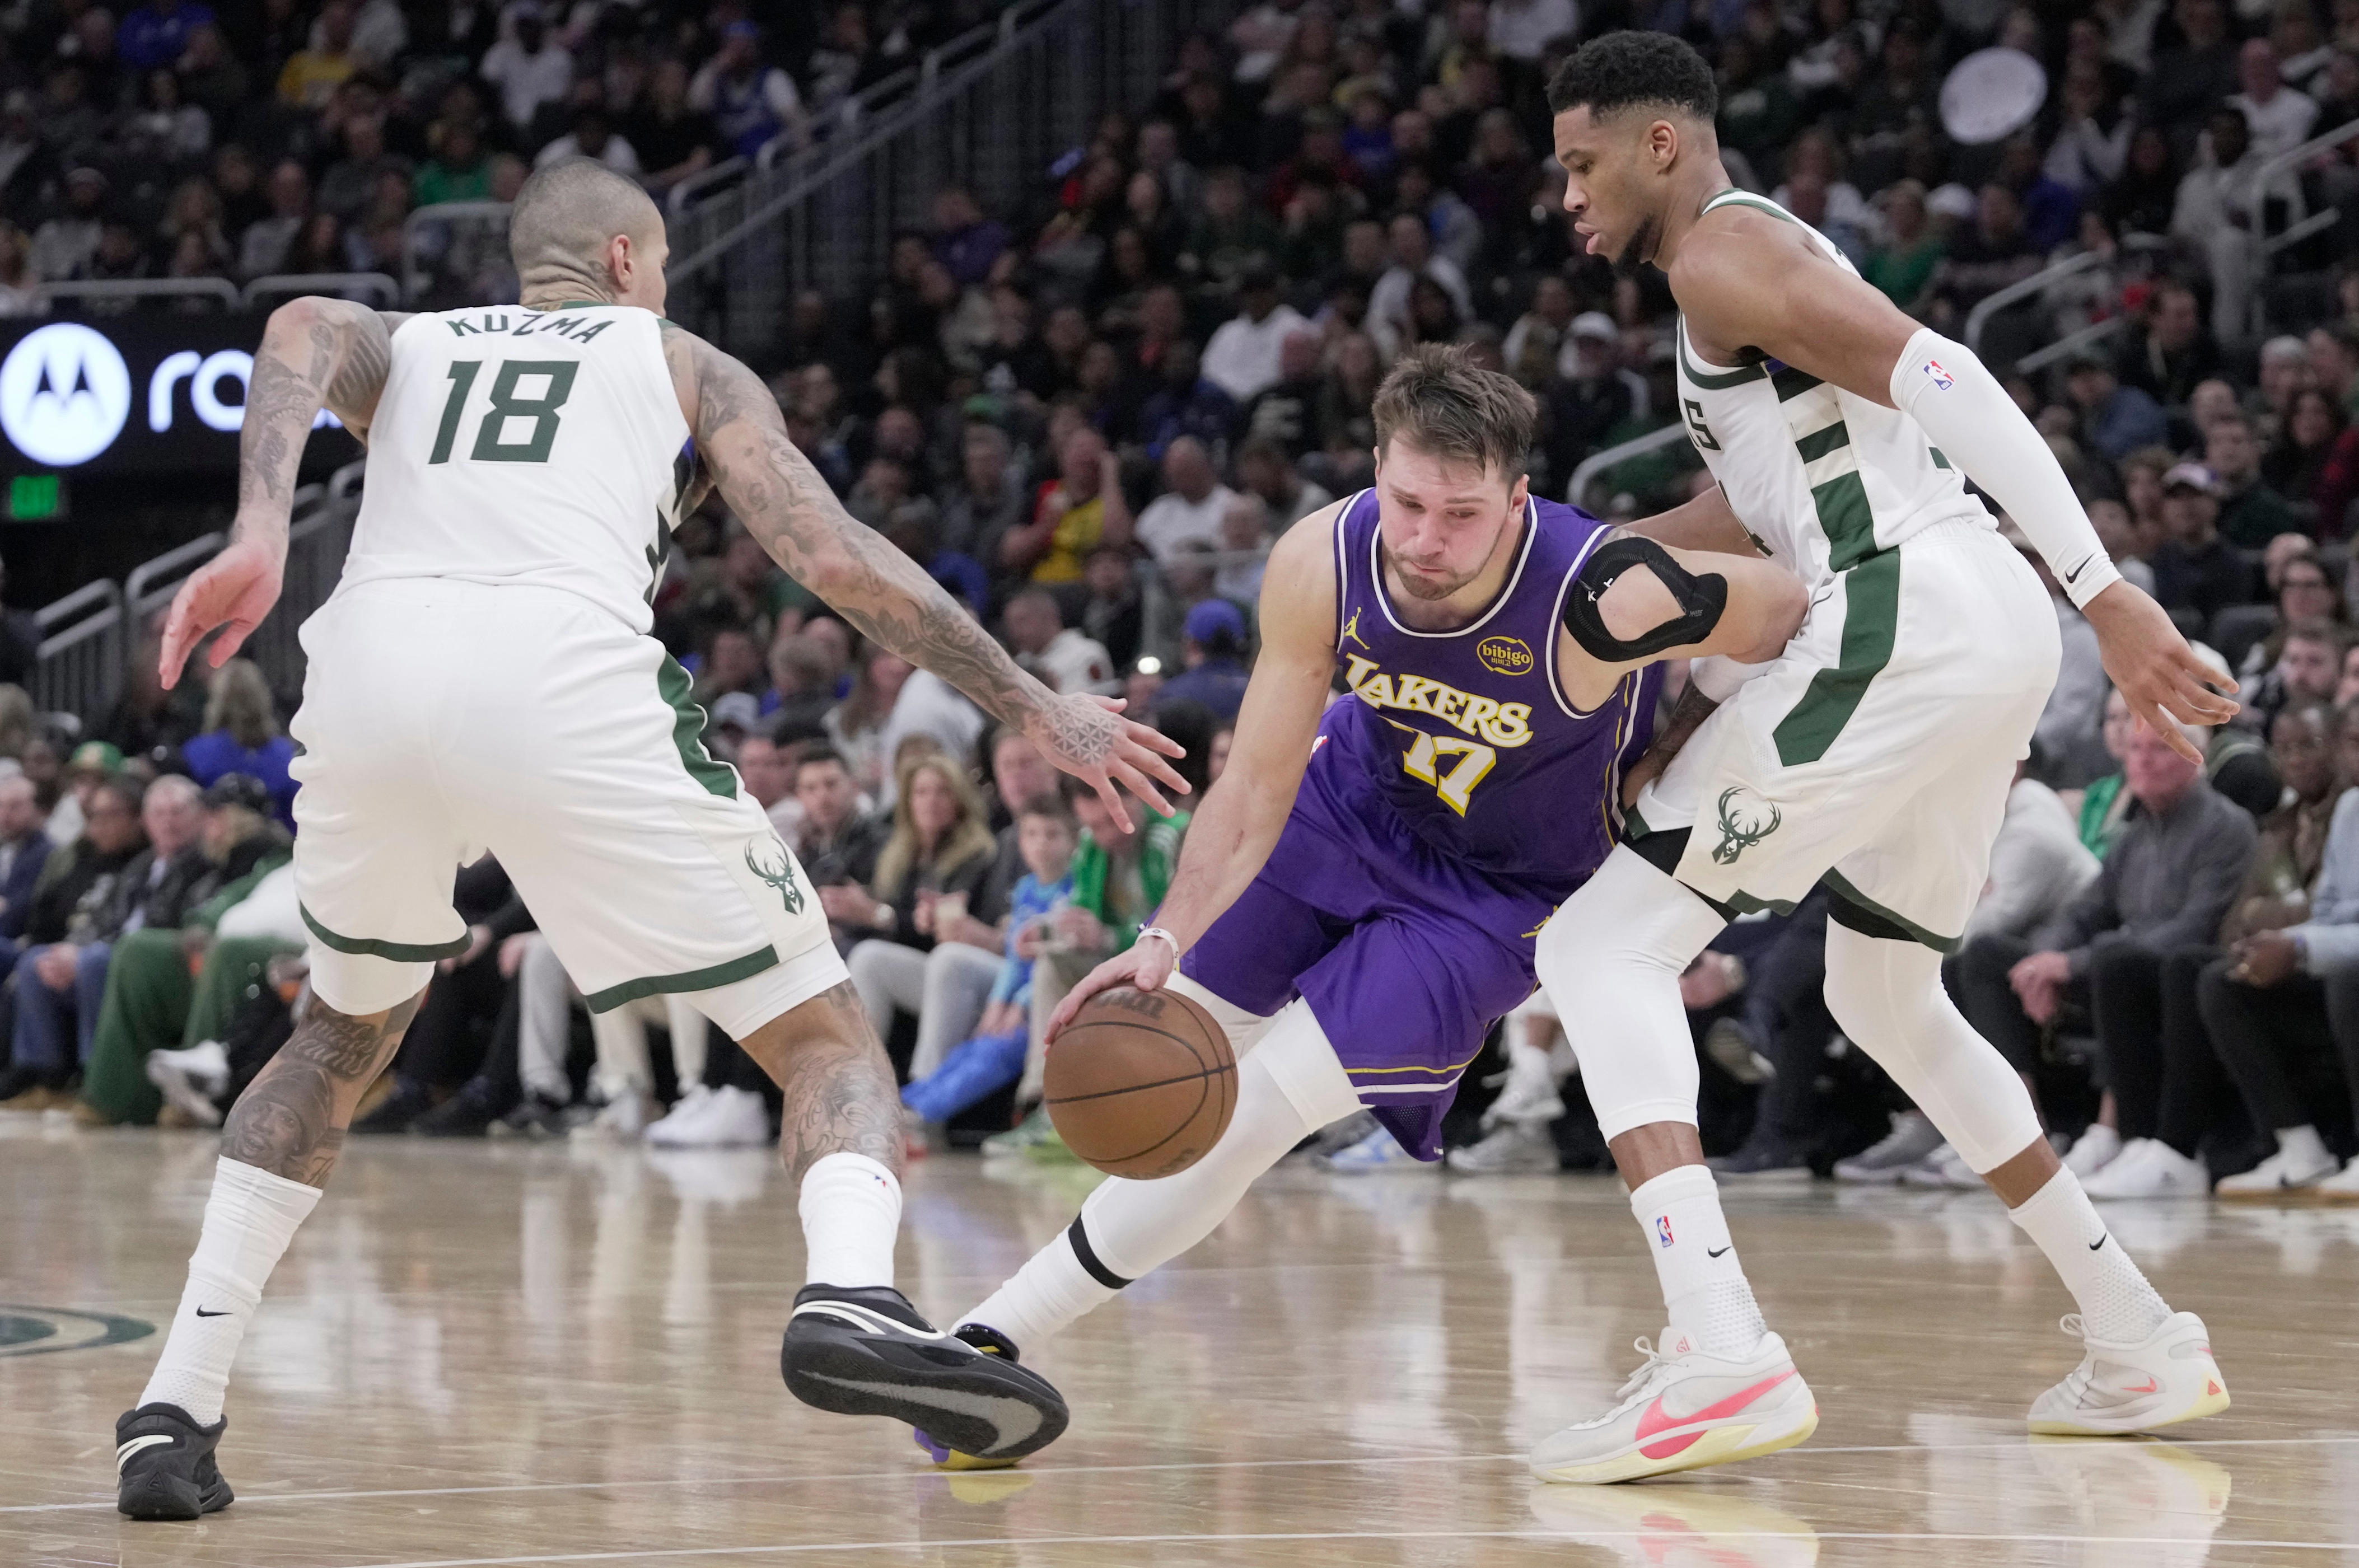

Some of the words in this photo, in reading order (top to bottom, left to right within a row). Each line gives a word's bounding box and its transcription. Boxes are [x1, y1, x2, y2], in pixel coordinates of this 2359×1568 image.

[446, 313, 616, 344] KUZMA
[428, 359, 580, 465] 18
[1482, 644, 1530, 666] bibigo
[1491, 657, 1511, 667] 비비고
[1345, 652, 1534, 748] LAKERS
